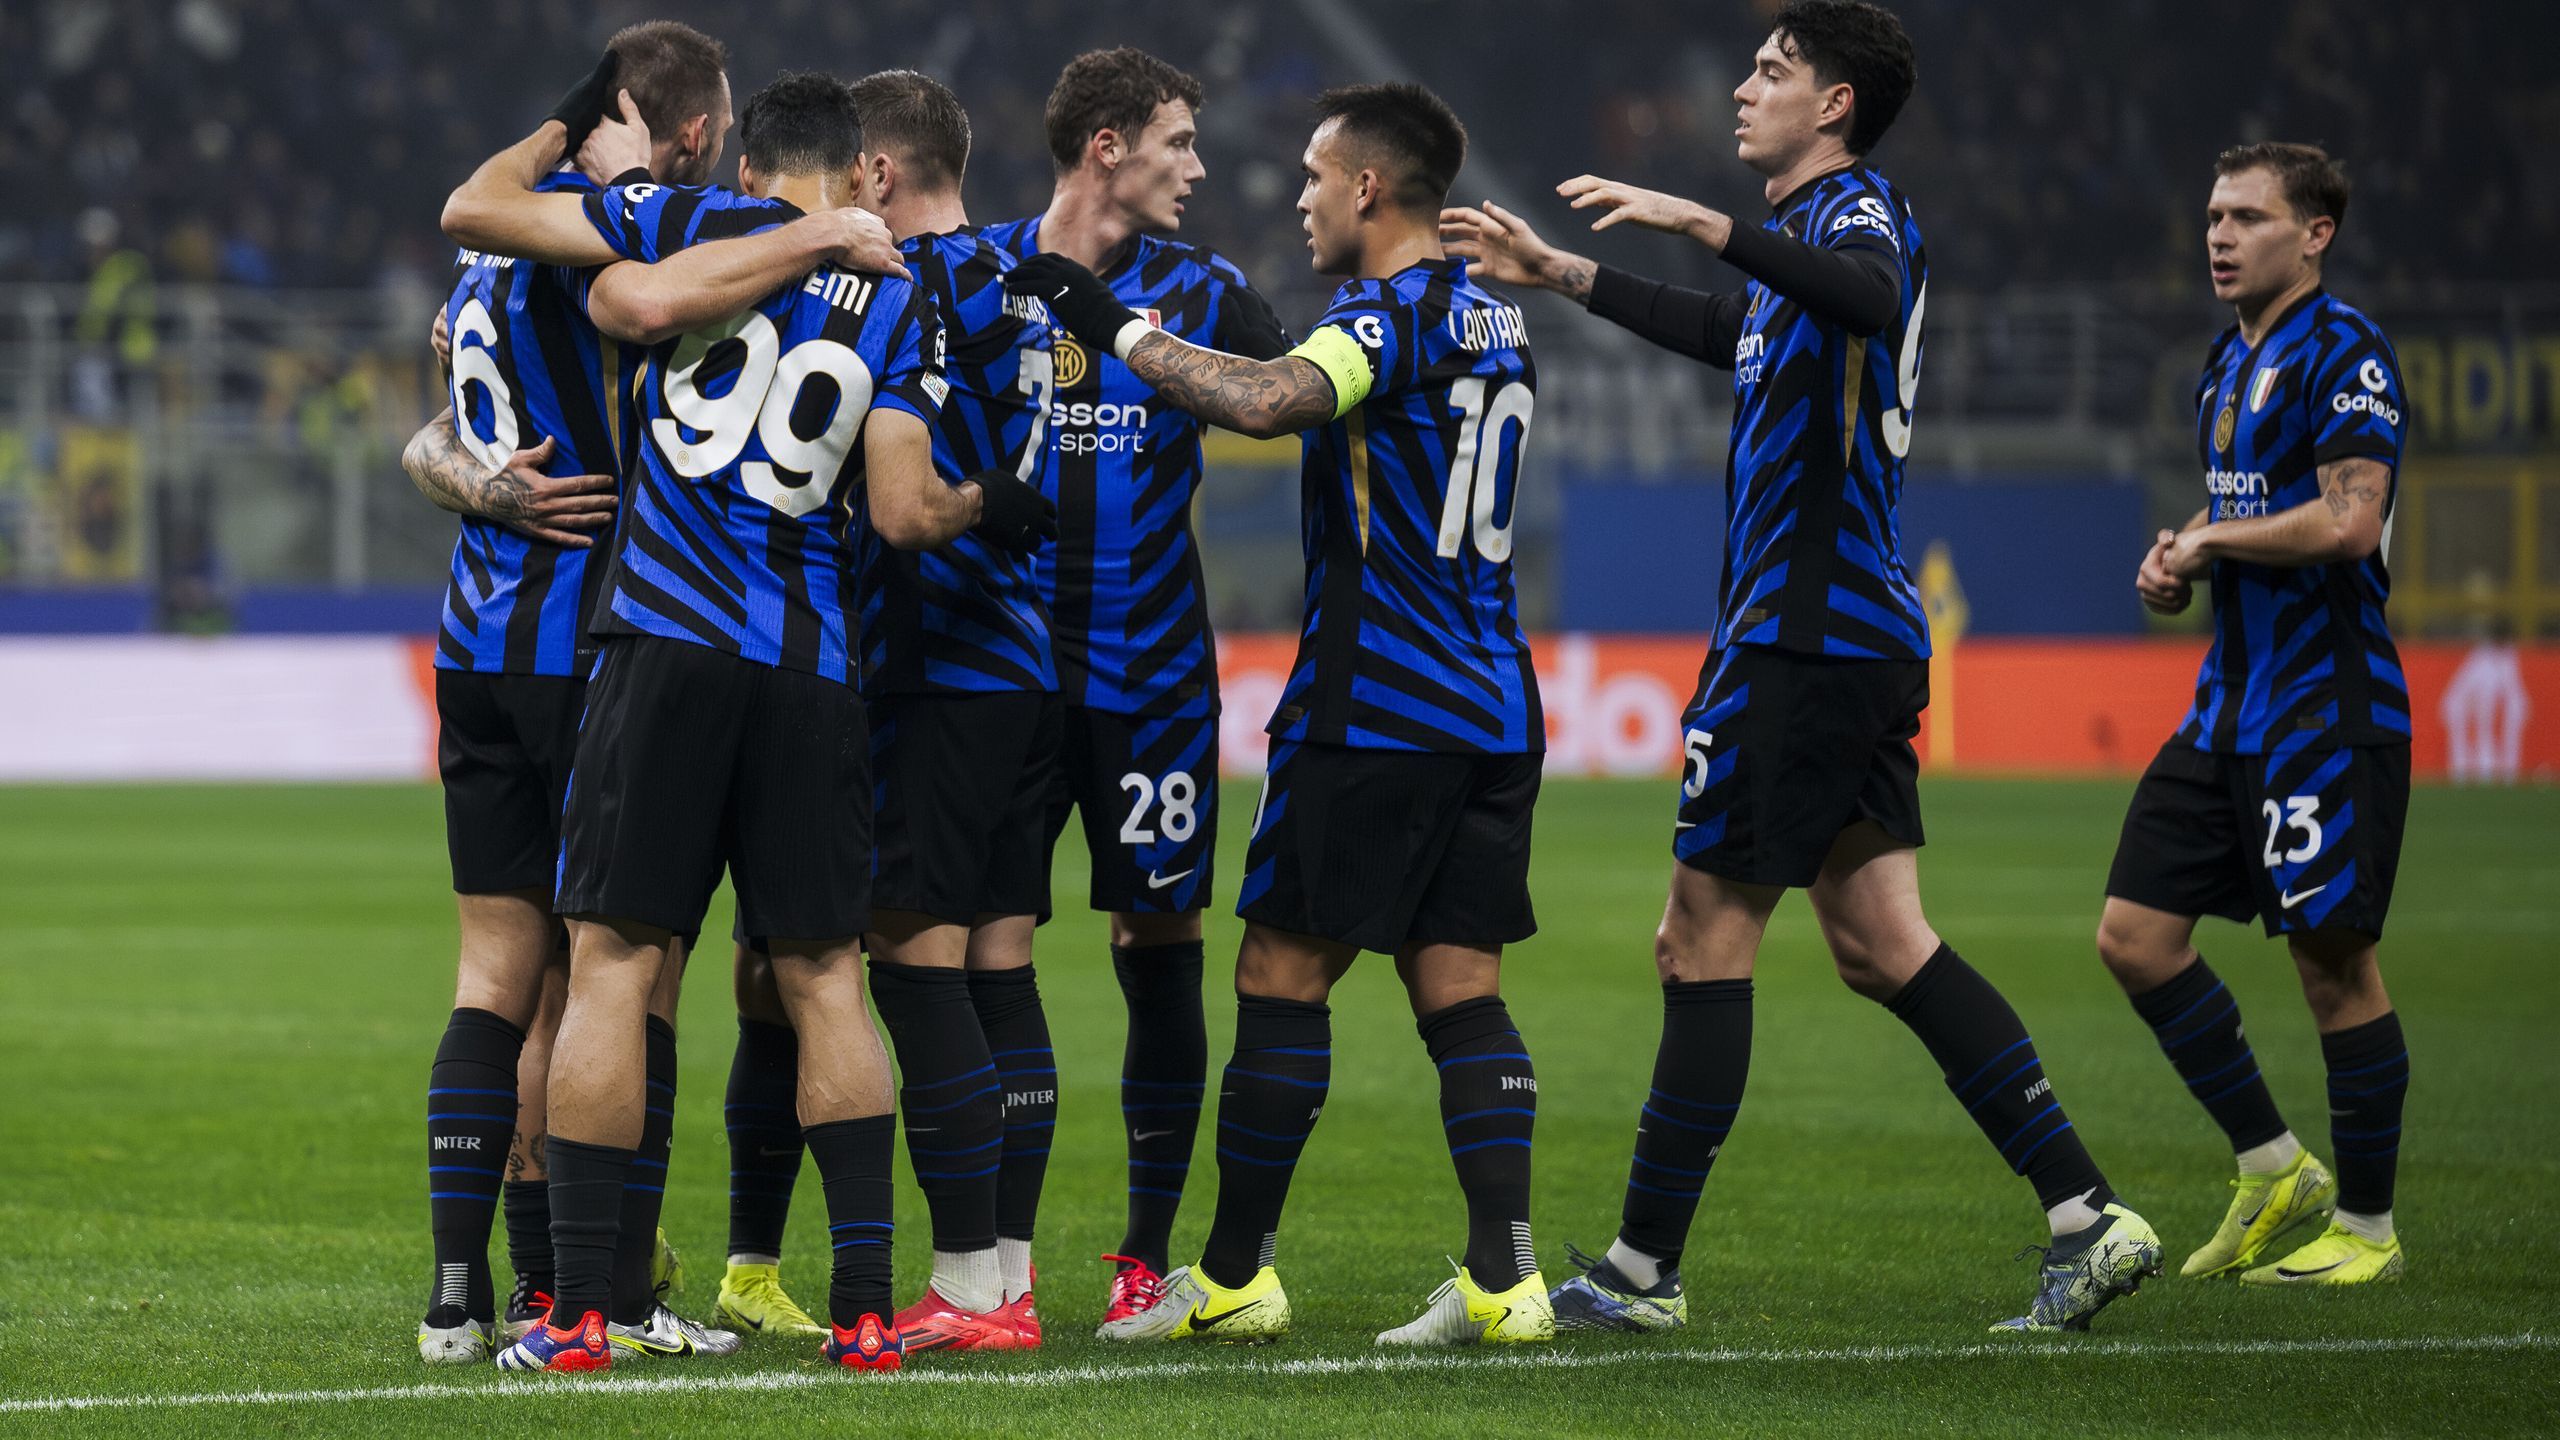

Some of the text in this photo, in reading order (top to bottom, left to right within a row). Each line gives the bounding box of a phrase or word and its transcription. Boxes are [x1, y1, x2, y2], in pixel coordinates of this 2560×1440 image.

[452, 299, 519, 474] 6
[651, 308, 874, 519] 99
[1017, 348, 1053, 483] 7
[2332, 392, 2400, 427] Gate.io
[1436, 376, 1536, 564] 10
[1119, 771, 1197, 844] 28
[2262, 795, 2323, 868] 23
[1007, 1089, 1055, 1107] INTER
[434, 1136, 481, 1150] INTER
